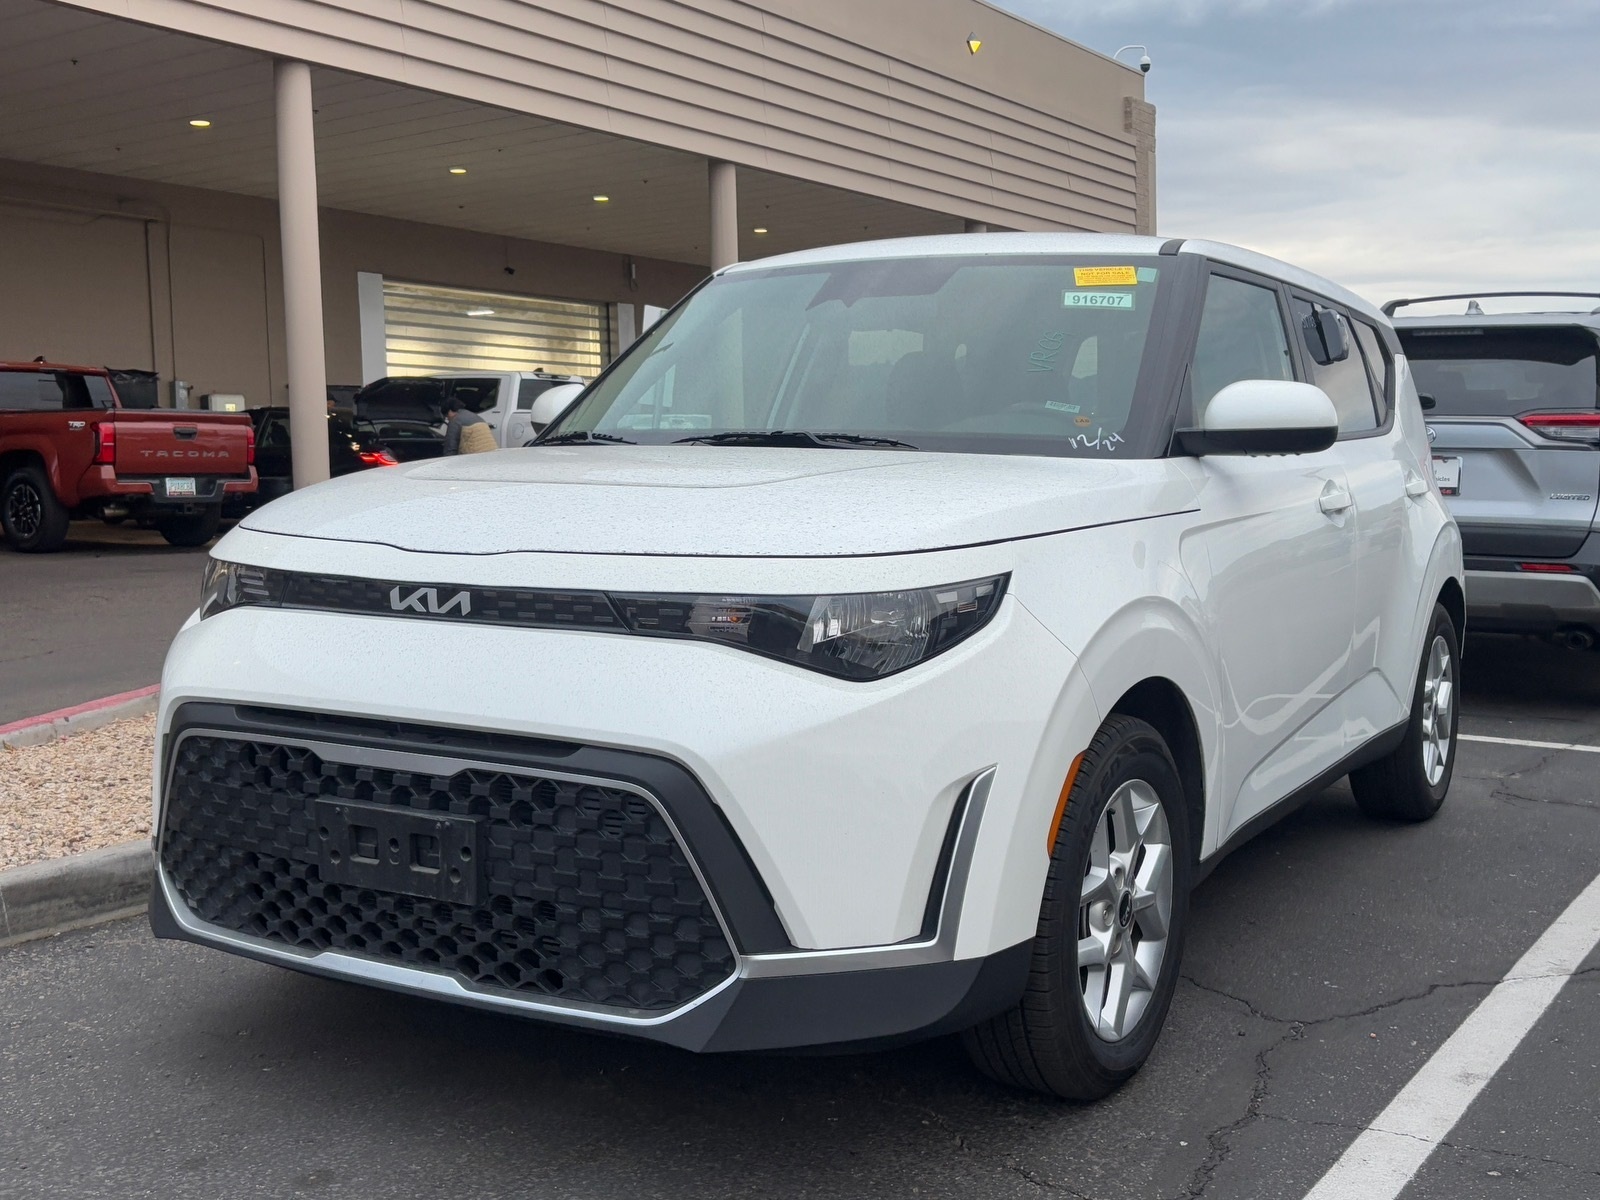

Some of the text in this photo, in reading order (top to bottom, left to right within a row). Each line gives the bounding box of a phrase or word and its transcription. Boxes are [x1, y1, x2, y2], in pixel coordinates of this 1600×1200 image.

[1072, 295, 1124, 305] 916707
[140, 450, 230, 458] TACOMA
[1549, 493, 1591, 501] LIMITED
[389, 585, 472, 616] KIA
